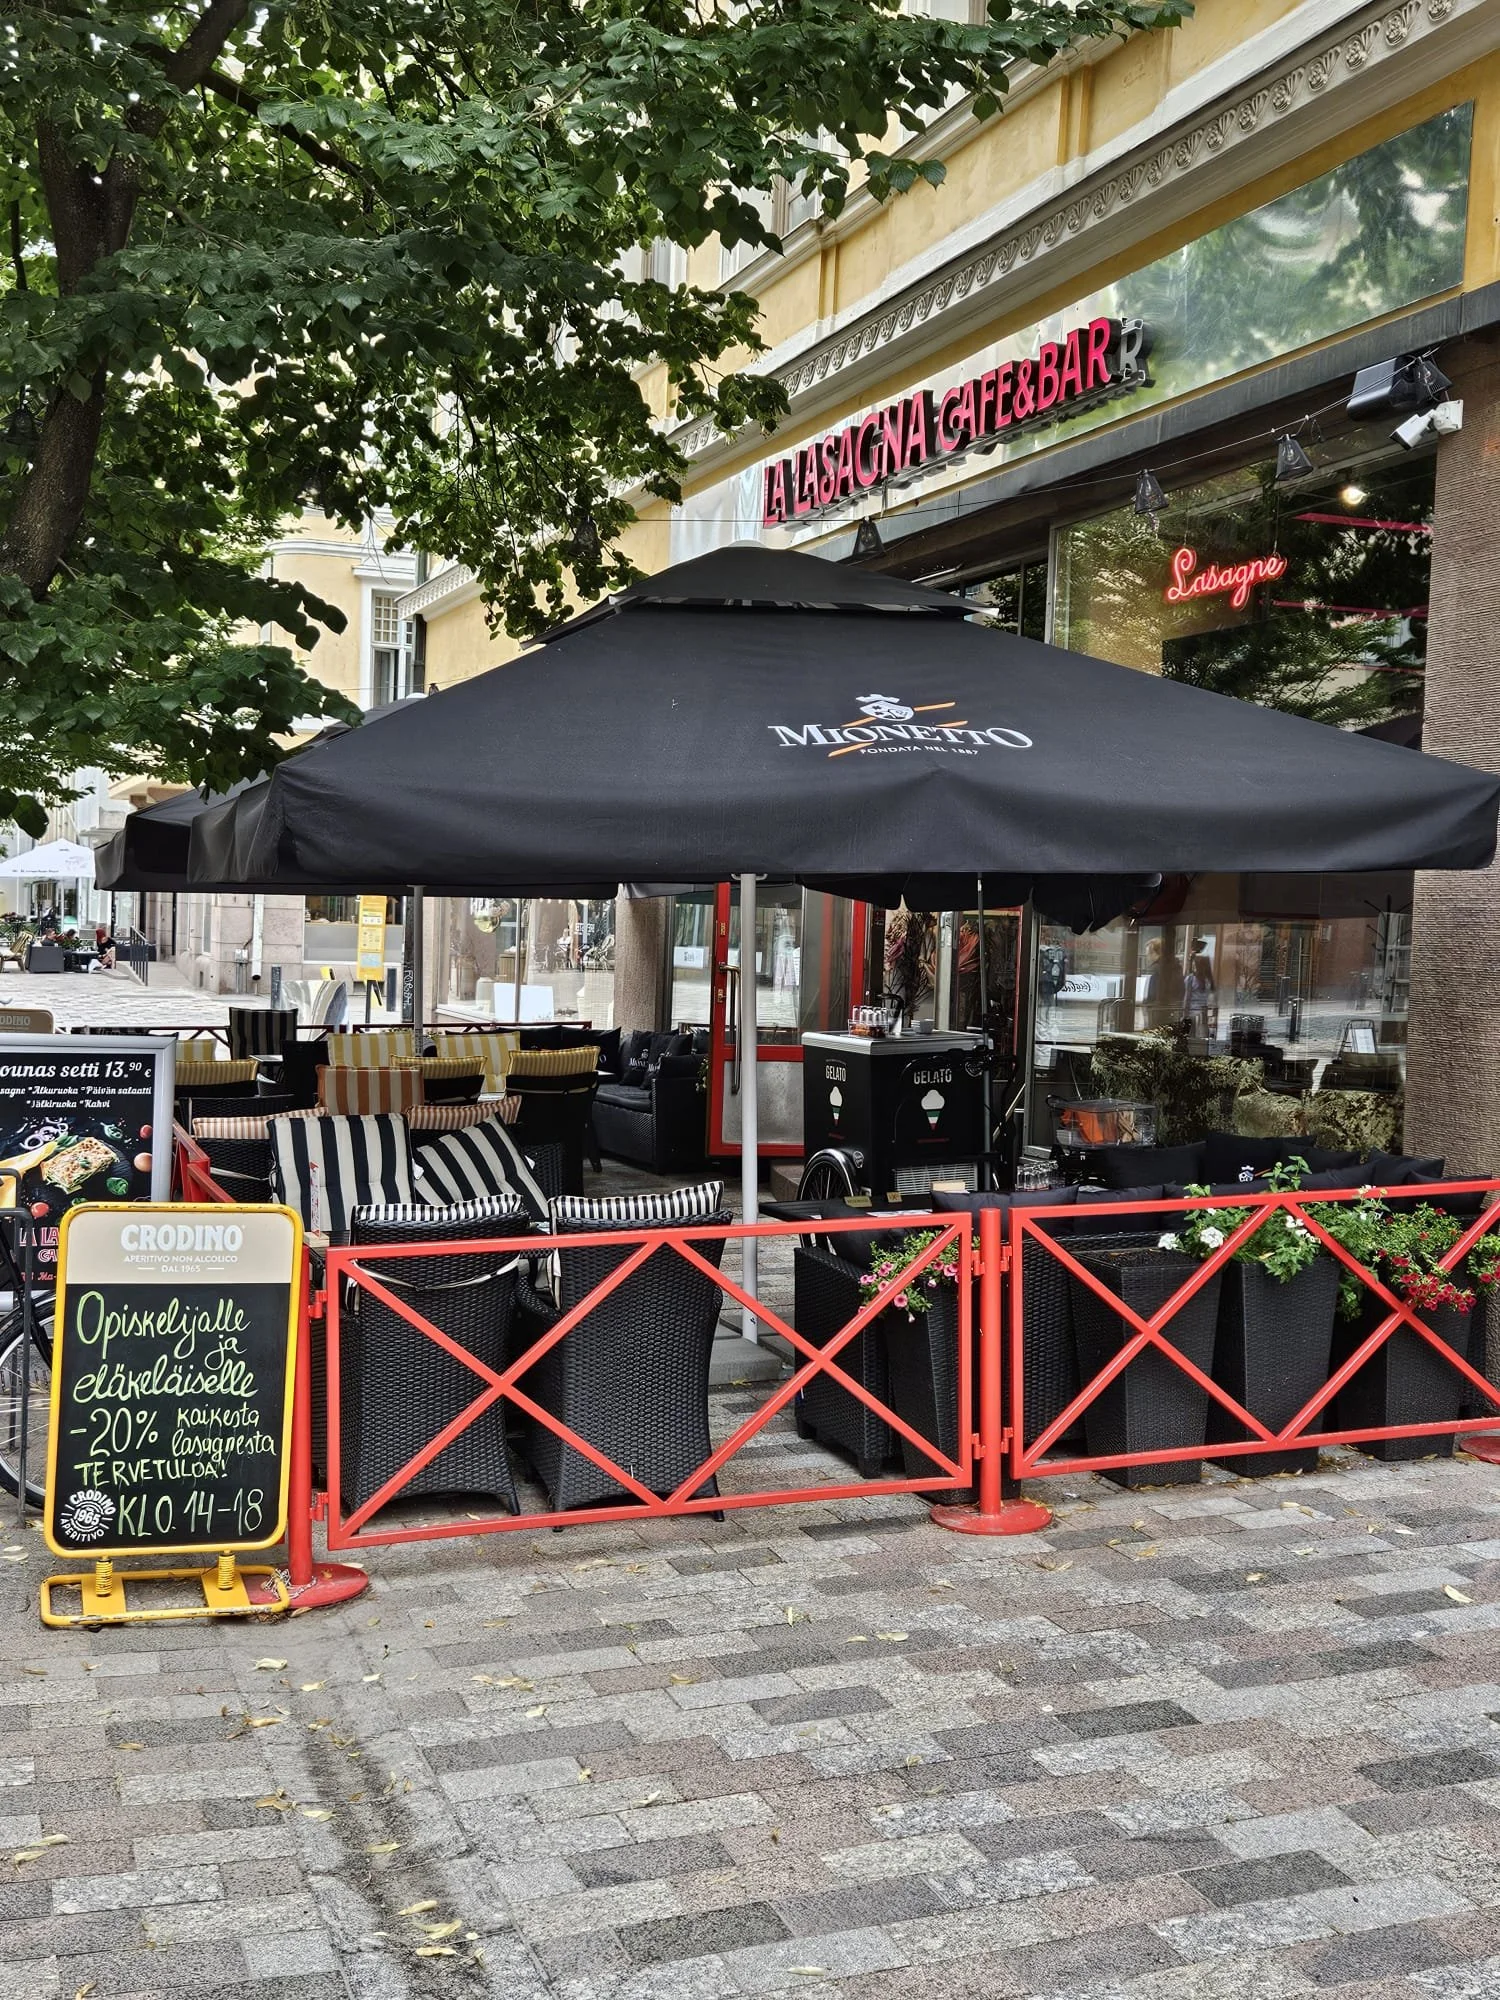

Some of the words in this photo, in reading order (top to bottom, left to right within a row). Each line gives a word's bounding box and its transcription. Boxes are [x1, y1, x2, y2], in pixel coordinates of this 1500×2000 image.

[763, 458, 787, 529] LA
[795, 389, 928, 513] LASAGNA
[937, 316, 1112, 452] CAFE&BAR
[1167, 548, 1285, 607] Lasagne
[860, 745, 922, 755] FONDATA
[924, 745, 948, 753] NEL
[60, 1062, 100, 1078] setti
[825, 1065, 847, 1082] GELATO
[913, 1069, 953, 1085] GELATO
[118, 1086, 152, 1095] salaatti
[121, 1224, 243, 1251] CRODINO
[123, 1255, 170, 1263] APERITIVO
[172, 1255, 193, 1263] NON
[195, 1255, 238, 1263] ALCOLICO
[161, 1264, 179, 1273] DAL
[181, 1264, 201, 1273] 1965
[77, 1290, 251, 1360] Opiskelijalle
[204, 1334, 247, 1370] ja
[73, 1354, 259, 1404] eläkeläiselle
[70, 1407, 158, 1457] -20%
[171, 1428, 277, 1463] lasagnesta
[74, 1458, 228, 1487] TERVETULOA!
[69, 1489, 116, 1515] CRODINO
[183, 1488, 264, 1536] 14-18
[60, 1518, 105, 1542] APERITIVO
[73, 1508, 102, 1526] 1965
